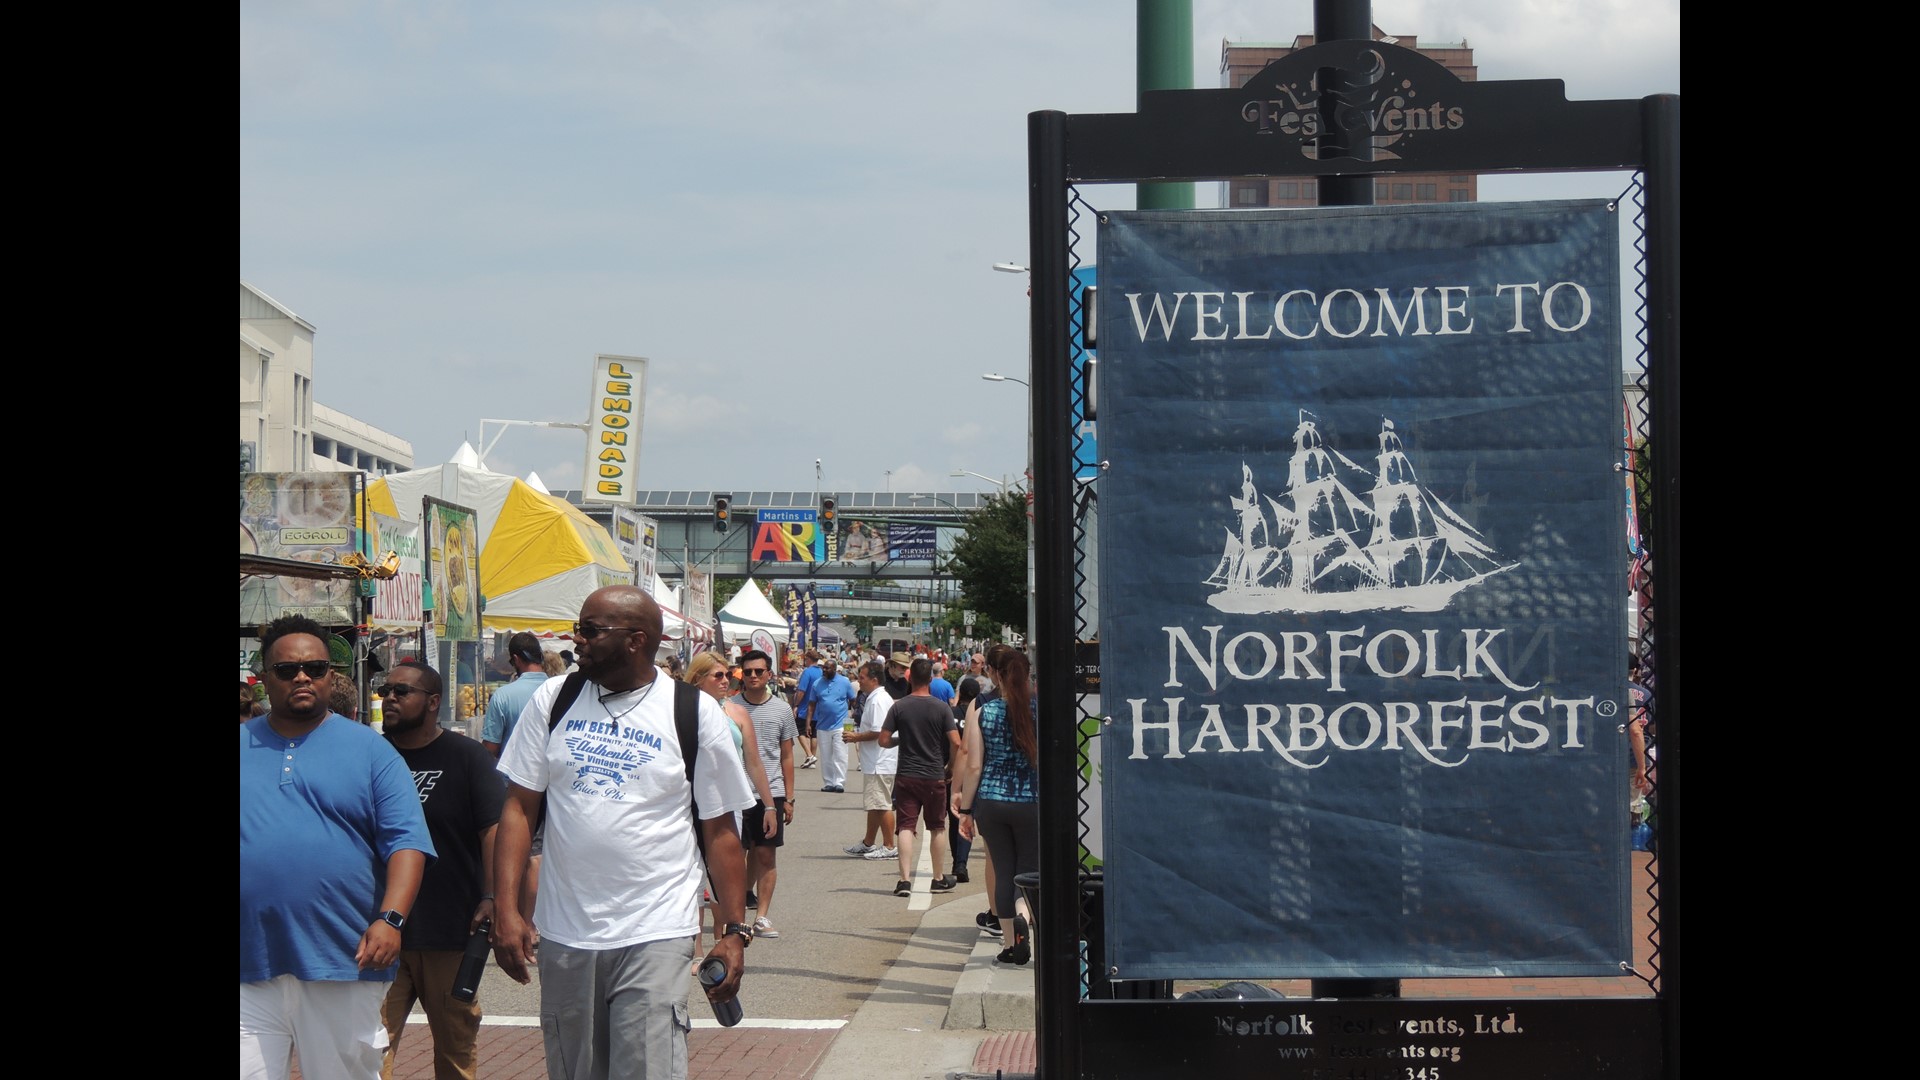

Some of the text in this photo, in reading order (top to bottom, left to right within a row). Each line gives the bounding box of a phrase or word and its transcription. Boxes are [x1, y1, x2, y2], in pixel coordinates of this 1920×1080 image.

[1241, 95, 1464, 135] Fesvents
[1125, 281, 1592, 343] WELCOME TO
[597, 362, 632, 496] LEMONADE
[764, 512, 813, 521] Martins La
[285, 532, 345, 541] EGGROLL
[374, 572, 422, 622] LEMONADE
[965, 615, 976, 625] 25
[1162, 625, 1540, 692] NORFOLK
[565, 719, 663, 751] PHI BETA SIGMA
[583, 733, 639, 749] FRATERNITY, INC.
[576, 740, 638, 762] Authentic
[587, 755, 620, 769] Vintage
[588, 767, 615, 776] QUALITY
[572, 781, 626, 801] Blue Phi
[1214, 1012, 1524, 1038] Norfolk Festvents, Ltd.
